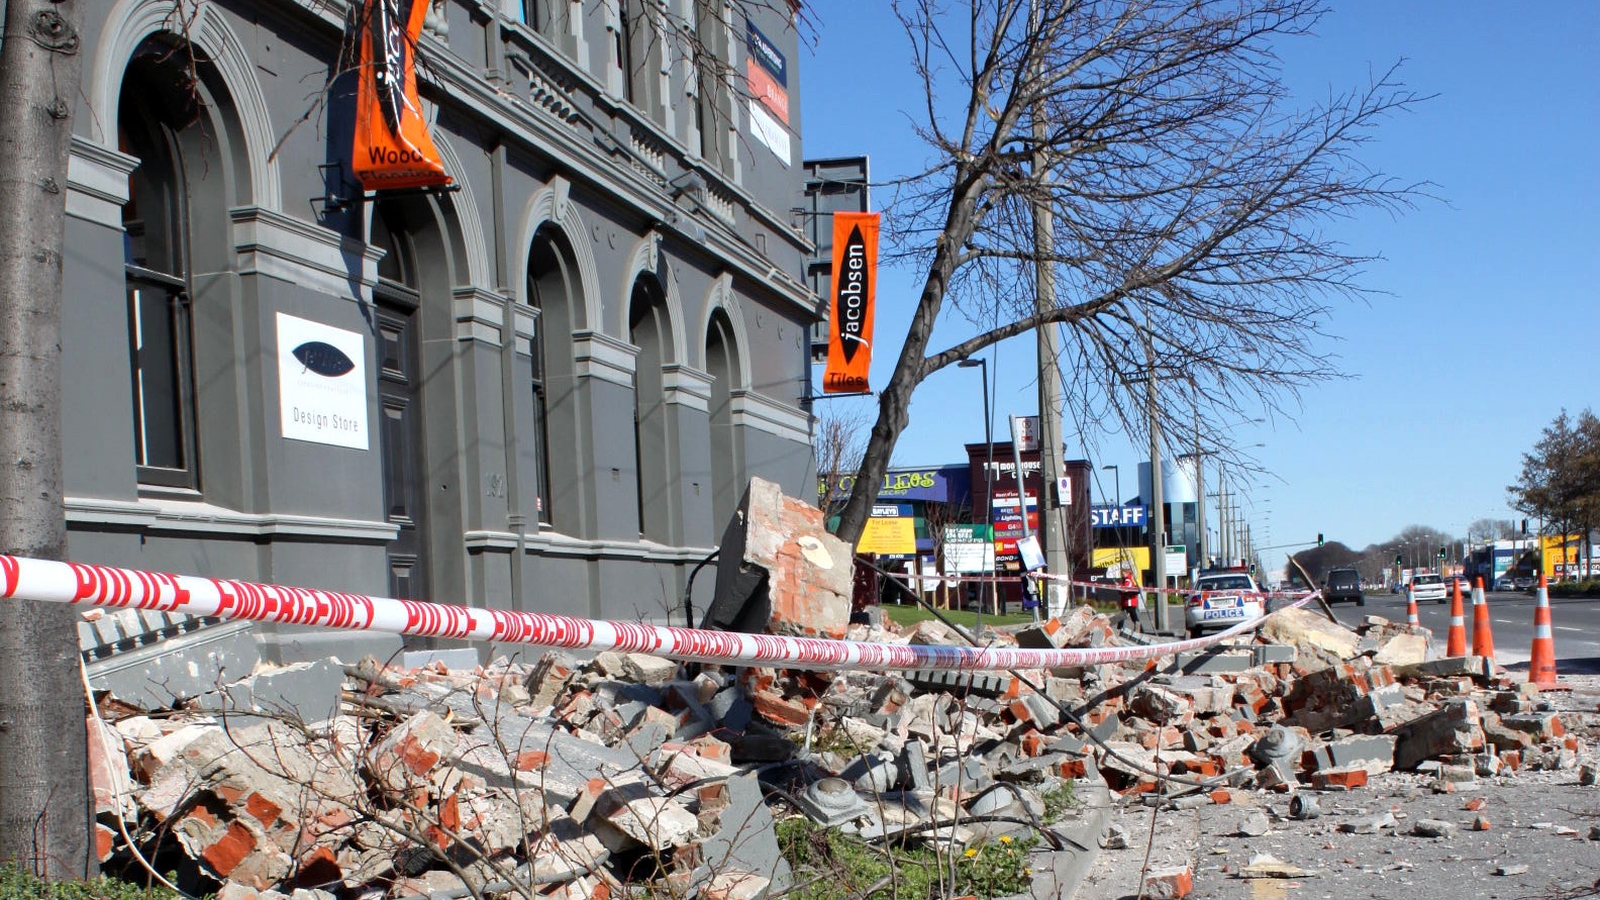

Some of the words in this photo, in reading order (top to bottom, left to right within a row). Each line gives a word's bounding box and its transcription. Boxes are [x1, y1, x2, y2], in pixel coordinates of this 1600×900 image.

[369, 146, 423, 165] Wood
[841, 244, 869, 348] jacobsen
[829, 372, 865, 387] Tiles
[293, 407, 328, 429] Design
[333, 414, 358, 432] Store
[1091, 507, 1143, 525] STAFF
[1205, 610, 1243, 619] POLICE
